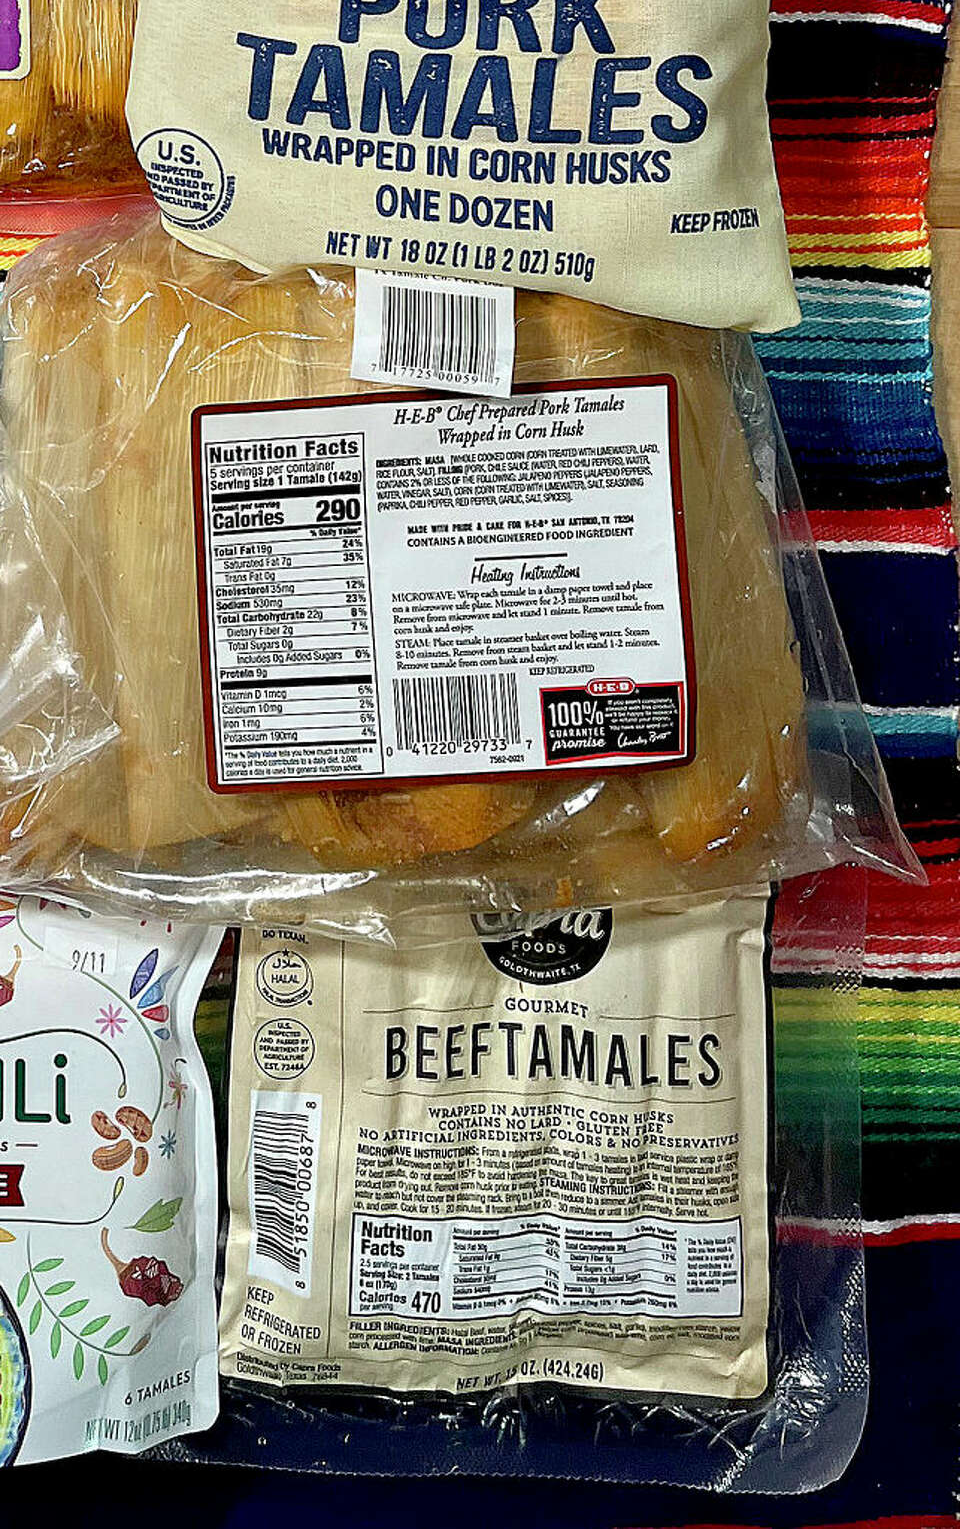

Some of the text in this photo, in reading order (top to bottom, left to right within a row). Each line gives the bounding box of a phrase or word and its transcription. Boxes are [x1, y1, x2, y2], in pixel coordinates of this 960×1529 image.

[236, 32, 713, 145] TAMALES
[262, 128, 671, 185] WRAPPED IN CORN HUSKS
[376, 185, 553, 231] ONE DOZEN
[670, 207, 759, 234] KEEP FROZEN
[446, 397, 625, 425] Chef Prepared Pork Tamales
[439, 421, 584, 446] Wrapped in Corn Husk
[209, 439, 359, 465] Nutrition Facts
[212, 499, 360, 529] Calories 290
[552, 735, 606, 751] promise
[511, 940, 567, 954] FOODS
[72, 951, 107, 973] 9/11
[271, 974, 299, 984] HALAL
[505, 998, 589, 1018] GOURMET
[386, 1023, 721, 1086] BEEF TAMALES
[247, 1287, 274, 1305] KEEP
[360, 1290, 441, 1313] Calories 470
[244, 1305, 321, 1339] REFRIGERATED
[242, 1325, 302, 1354] OR FROZEN
